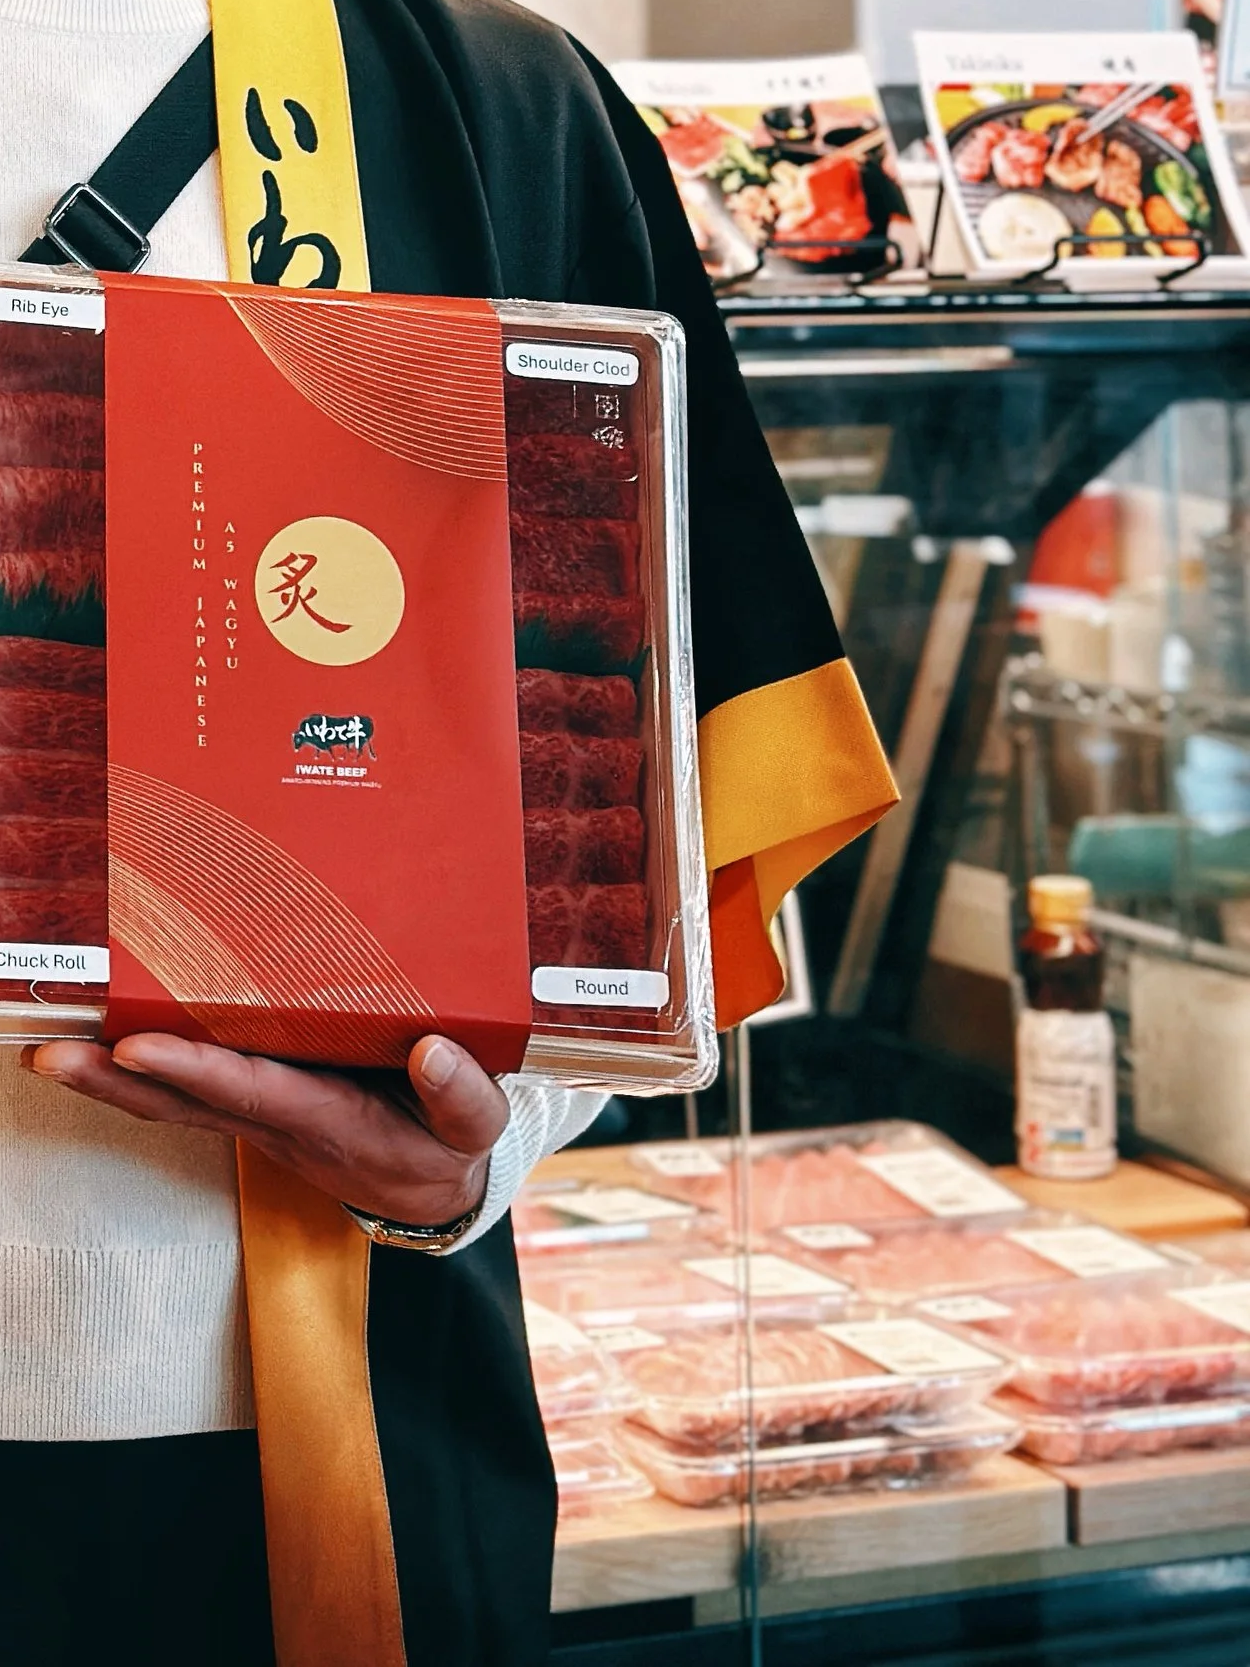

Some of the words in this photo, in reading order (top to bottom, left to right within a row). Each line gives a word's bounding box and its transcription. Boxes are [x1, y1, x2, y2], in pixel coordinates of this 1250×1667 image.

[246, 87, 341, 290] いわ
[12, 299, 36, 313] Rib
[42, 302, 68, 318] Eye
[518, 355, 589, 372] Shoulder
[593, 361, 629, 376] Clod
[191, 443, 208, 570] PREMIUM
[224, 521, 236, 553] A5
[267, 551, 352, 633] 炙
[224, 578, 238, 669] WAGYU
[195, 596, 208, 747] JAPANESE
[305, 715, 366, 749] いわて牛
[296, 765, 334, 776] IWATE
[336, 767, 367, 777] BEEF
[54, 954, 86, 969] Roll
[576, 980, 628, 995] Round
